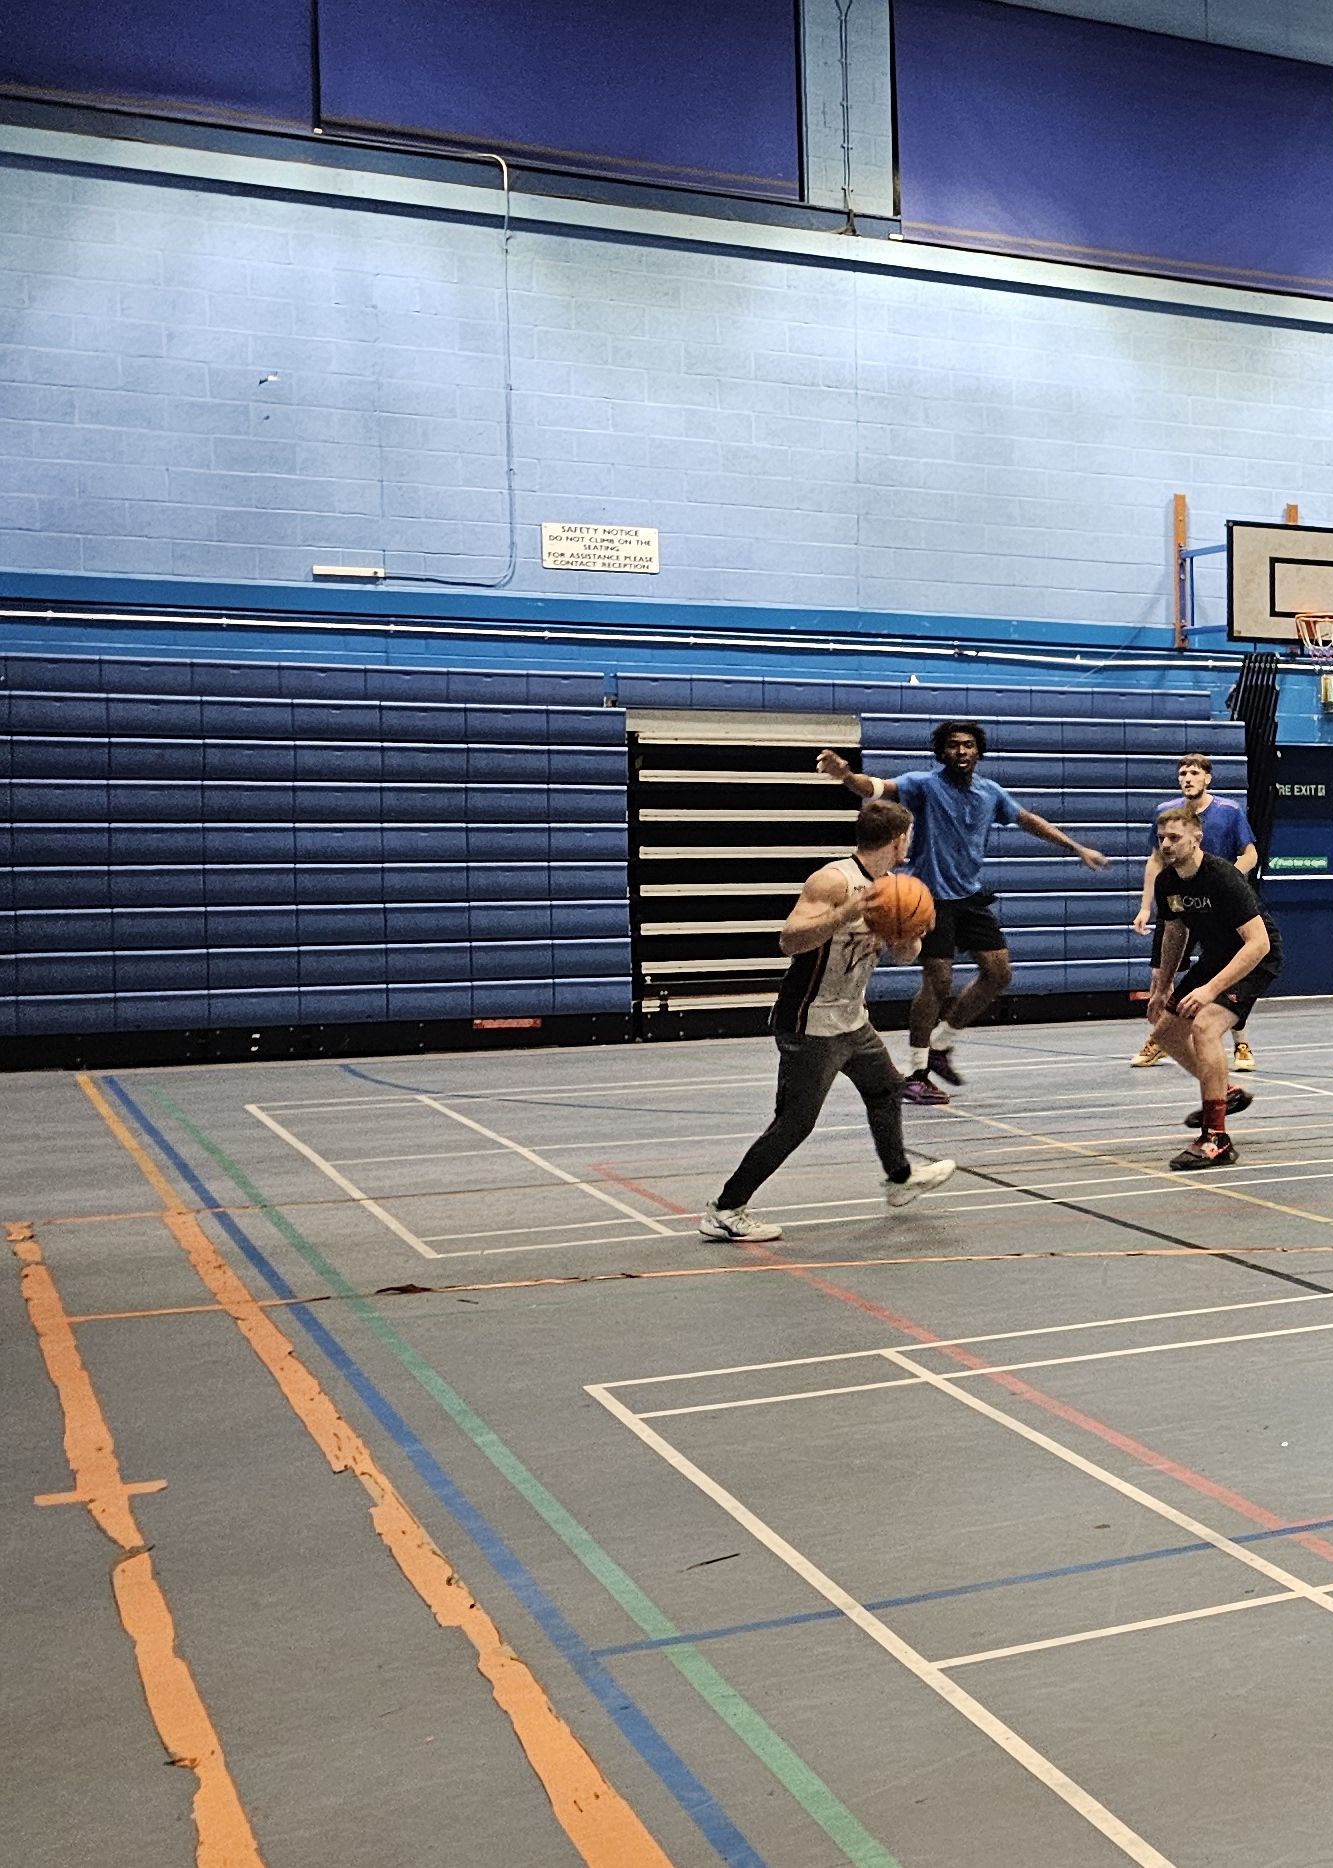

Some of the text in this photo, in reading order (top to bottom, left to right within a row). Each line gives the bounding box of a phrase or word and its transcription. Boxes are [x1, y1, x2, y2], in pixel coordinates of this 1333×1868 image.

[561, 526, 640, 537] SAFETY NOTICE
[548, 534, 562, 542] DO
[588, 537, 615, 545] CLIMB
[583, 544, 620, 552] SEATING
[547, 551, 654, 563] FOR ASSISTANCE PLEASE
[553, 559, 650, 570] CONTACT RECEPTION
[1294, 784, 1316, 796] EXIT
